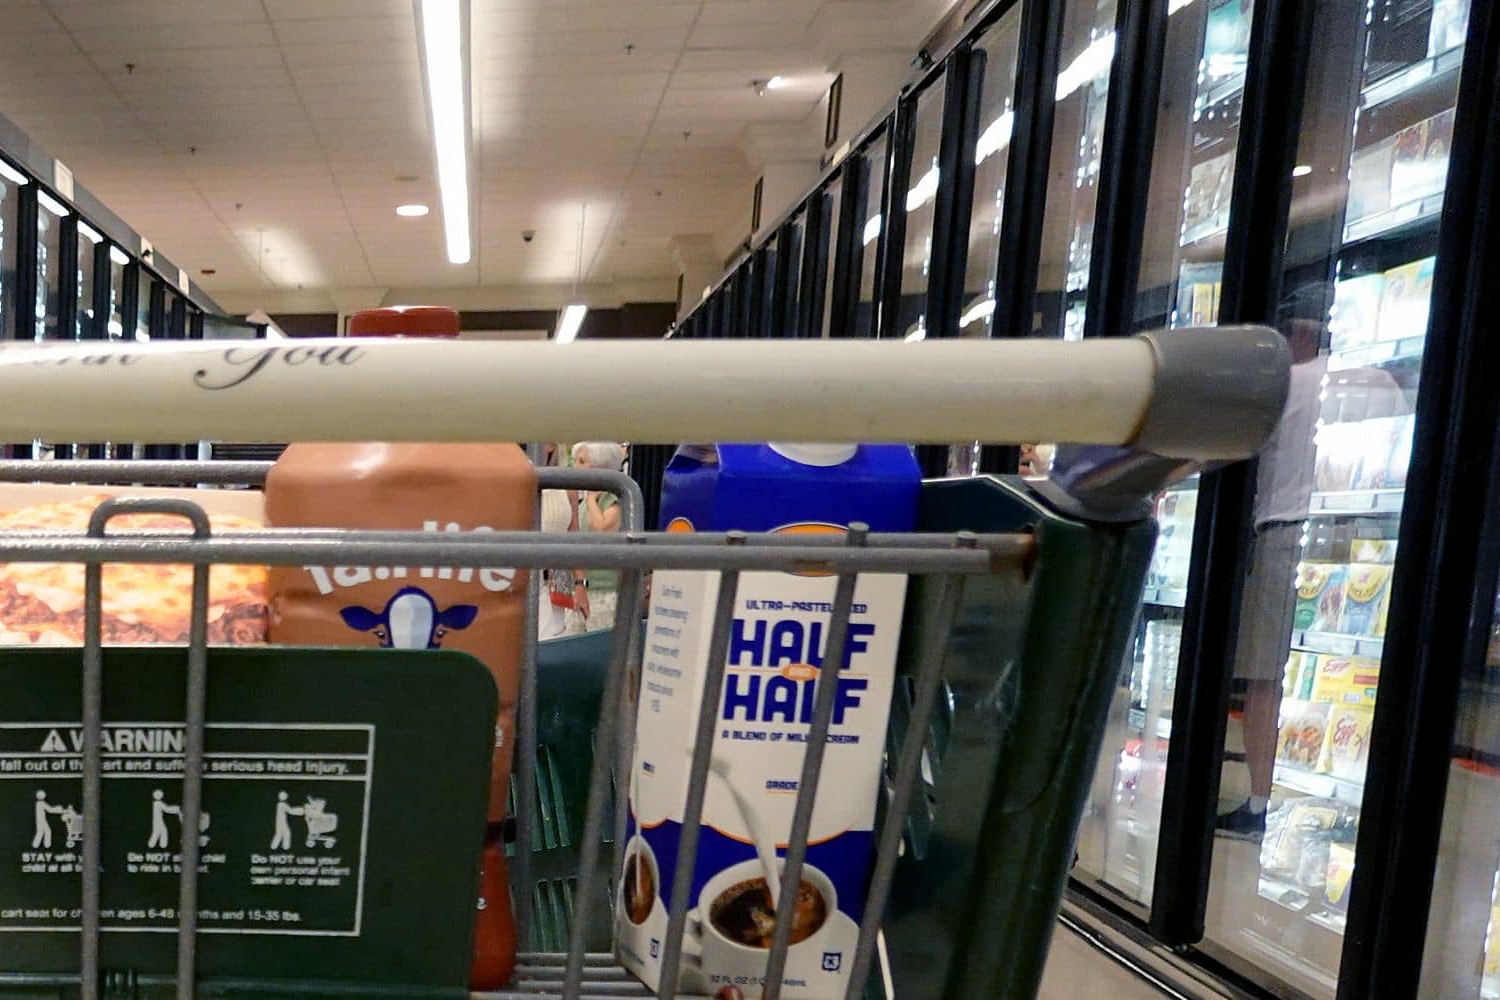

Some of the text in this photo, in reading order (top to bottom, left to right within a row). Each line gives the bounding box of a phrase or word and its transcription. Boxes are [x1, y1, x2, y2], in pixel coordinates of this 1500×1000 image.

[729, 618, 876, 671] HALF
[722, 673, 869, 725] HALF
[732, 730, 767, 742] BLEND
[770, 732, 784, 743] OF
[787, 733, 809, 744] MIL
[1, 758, 22, 772] fall
[25, 760, 48, 772] out
[51, 758, 67, 772] of
[100, 760, 122, 773] art
[124, 759, 151, 772] and
[155, 759, 185, 773] suff
[211, 760, 265, 773] serious
[267, 760, 301, 773] head
[305, 761, 350, 776] injury.
[21, 853, 53, 863] STAY
[127, 852, 143, 864] Do
[146, 852, 170, 864] NOT
[251, 854, 267, 865] Do
[269, 855, 294, 866] NOT
[1, 908, 23, 919] cart
[52, 908, 68, 919] for
[116, 910, 146, 922] ages
[221, 910, 245, 920] and
